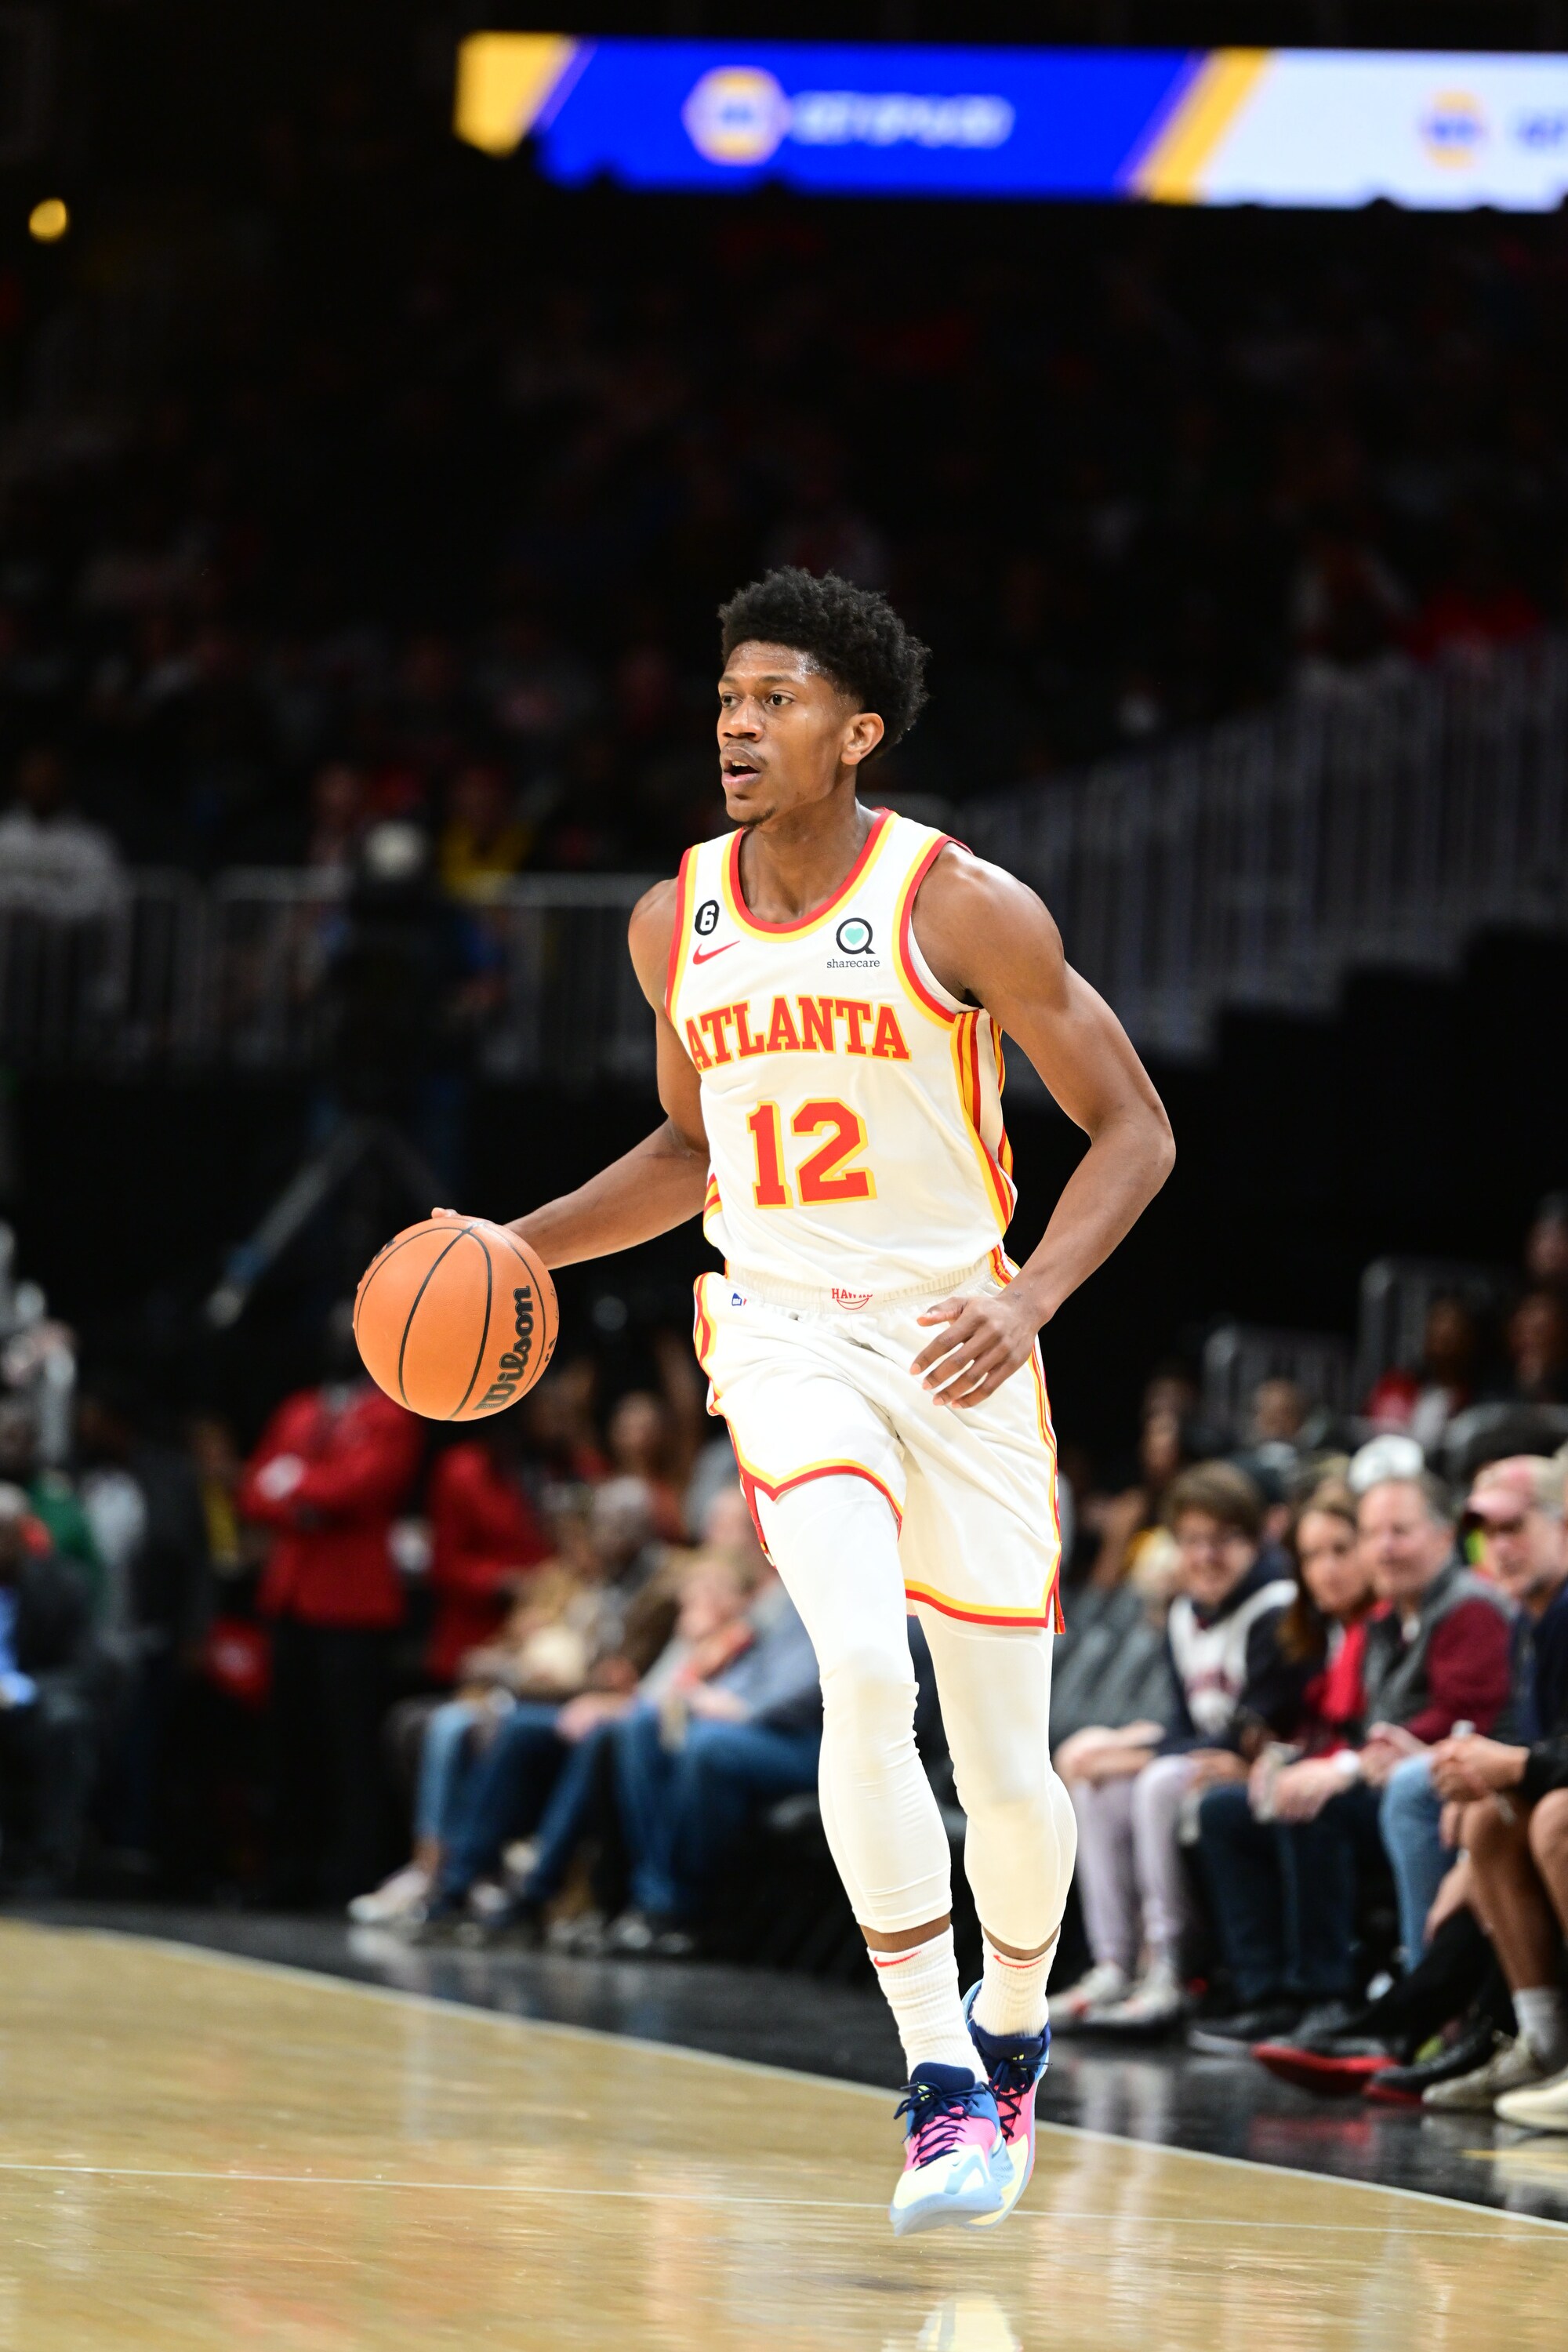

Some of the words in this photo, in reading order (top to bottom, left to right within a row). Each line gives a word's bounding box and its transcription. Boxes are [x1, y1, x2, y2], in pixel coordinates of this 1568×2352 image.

[699, 904, 716, 931] 6
[826, 958, 880, 968] sharecare
[685, 995, 912, 1073] ATLANTA
[746, 1098, 877, 1208] 12
[473, 1286, 533, 1410] Wilson
